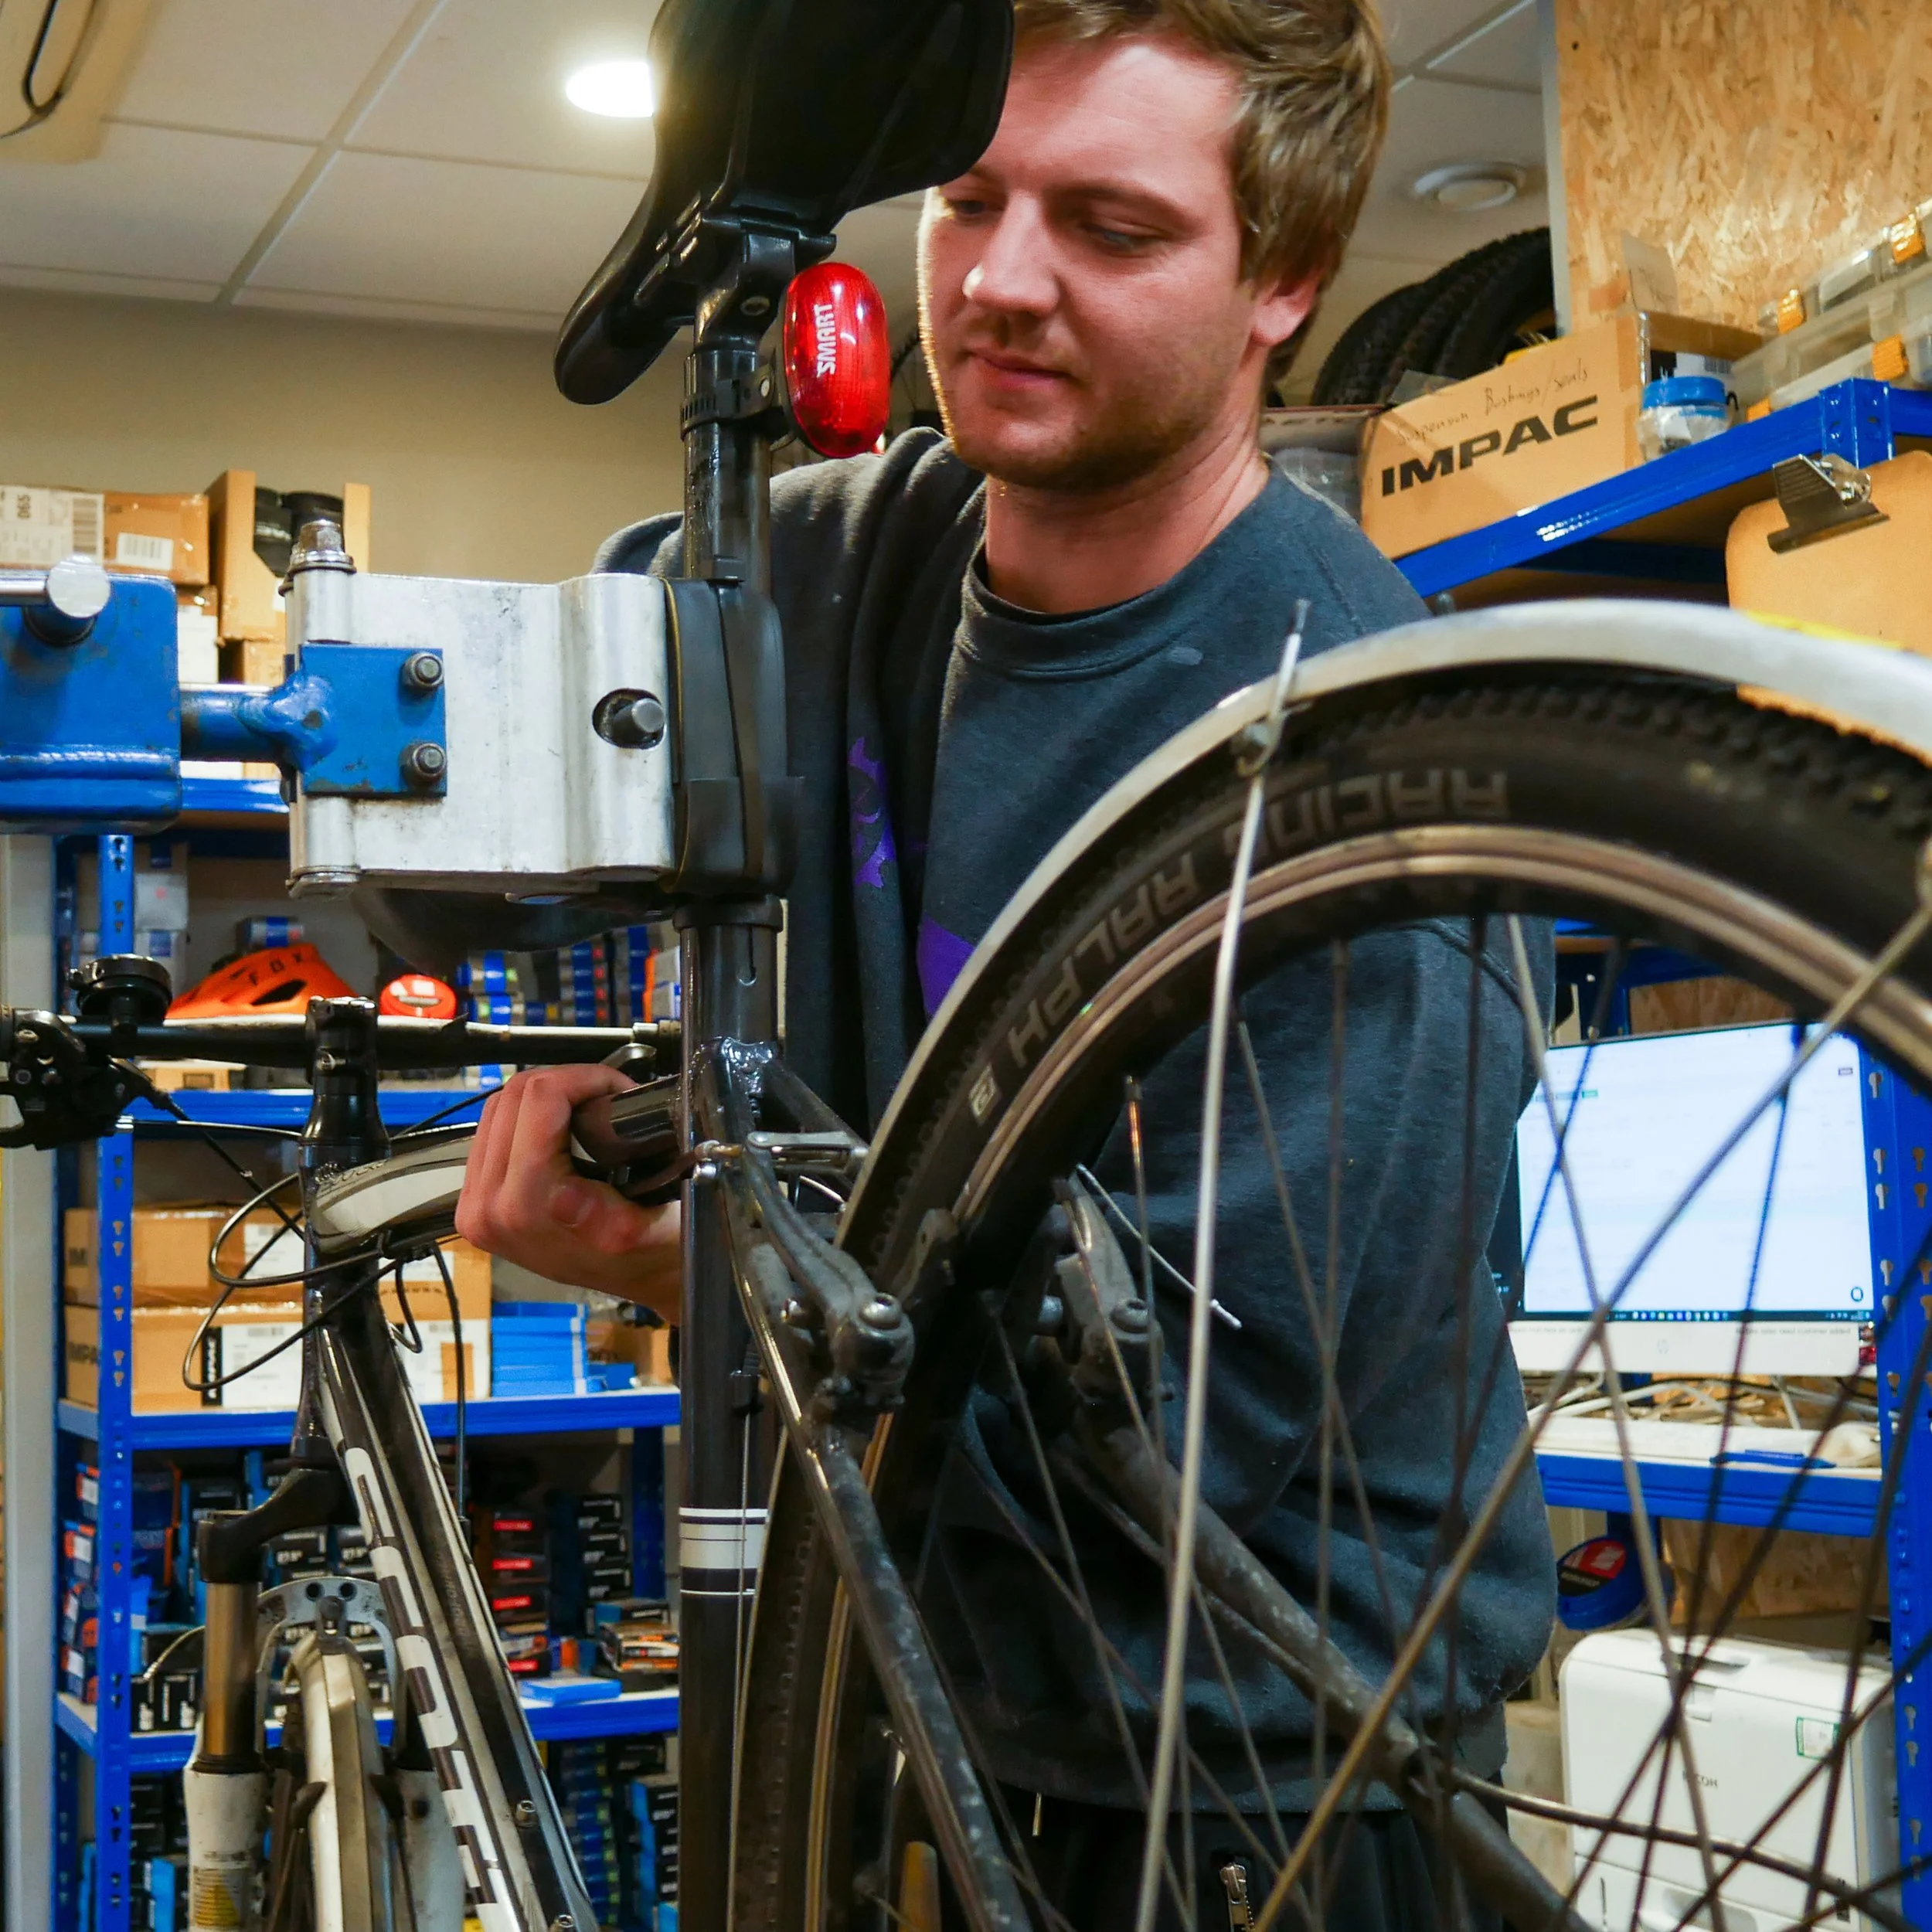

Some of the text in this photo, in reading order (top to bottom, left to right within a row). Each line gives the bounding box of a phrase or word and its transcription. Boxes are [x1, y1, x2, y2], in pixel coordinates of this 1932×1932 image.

[814, 304, 836, 378] SMART
[1382, 393, 1598, 497] IMPAC
[1007, 851, 1200, 1068] RALPH
